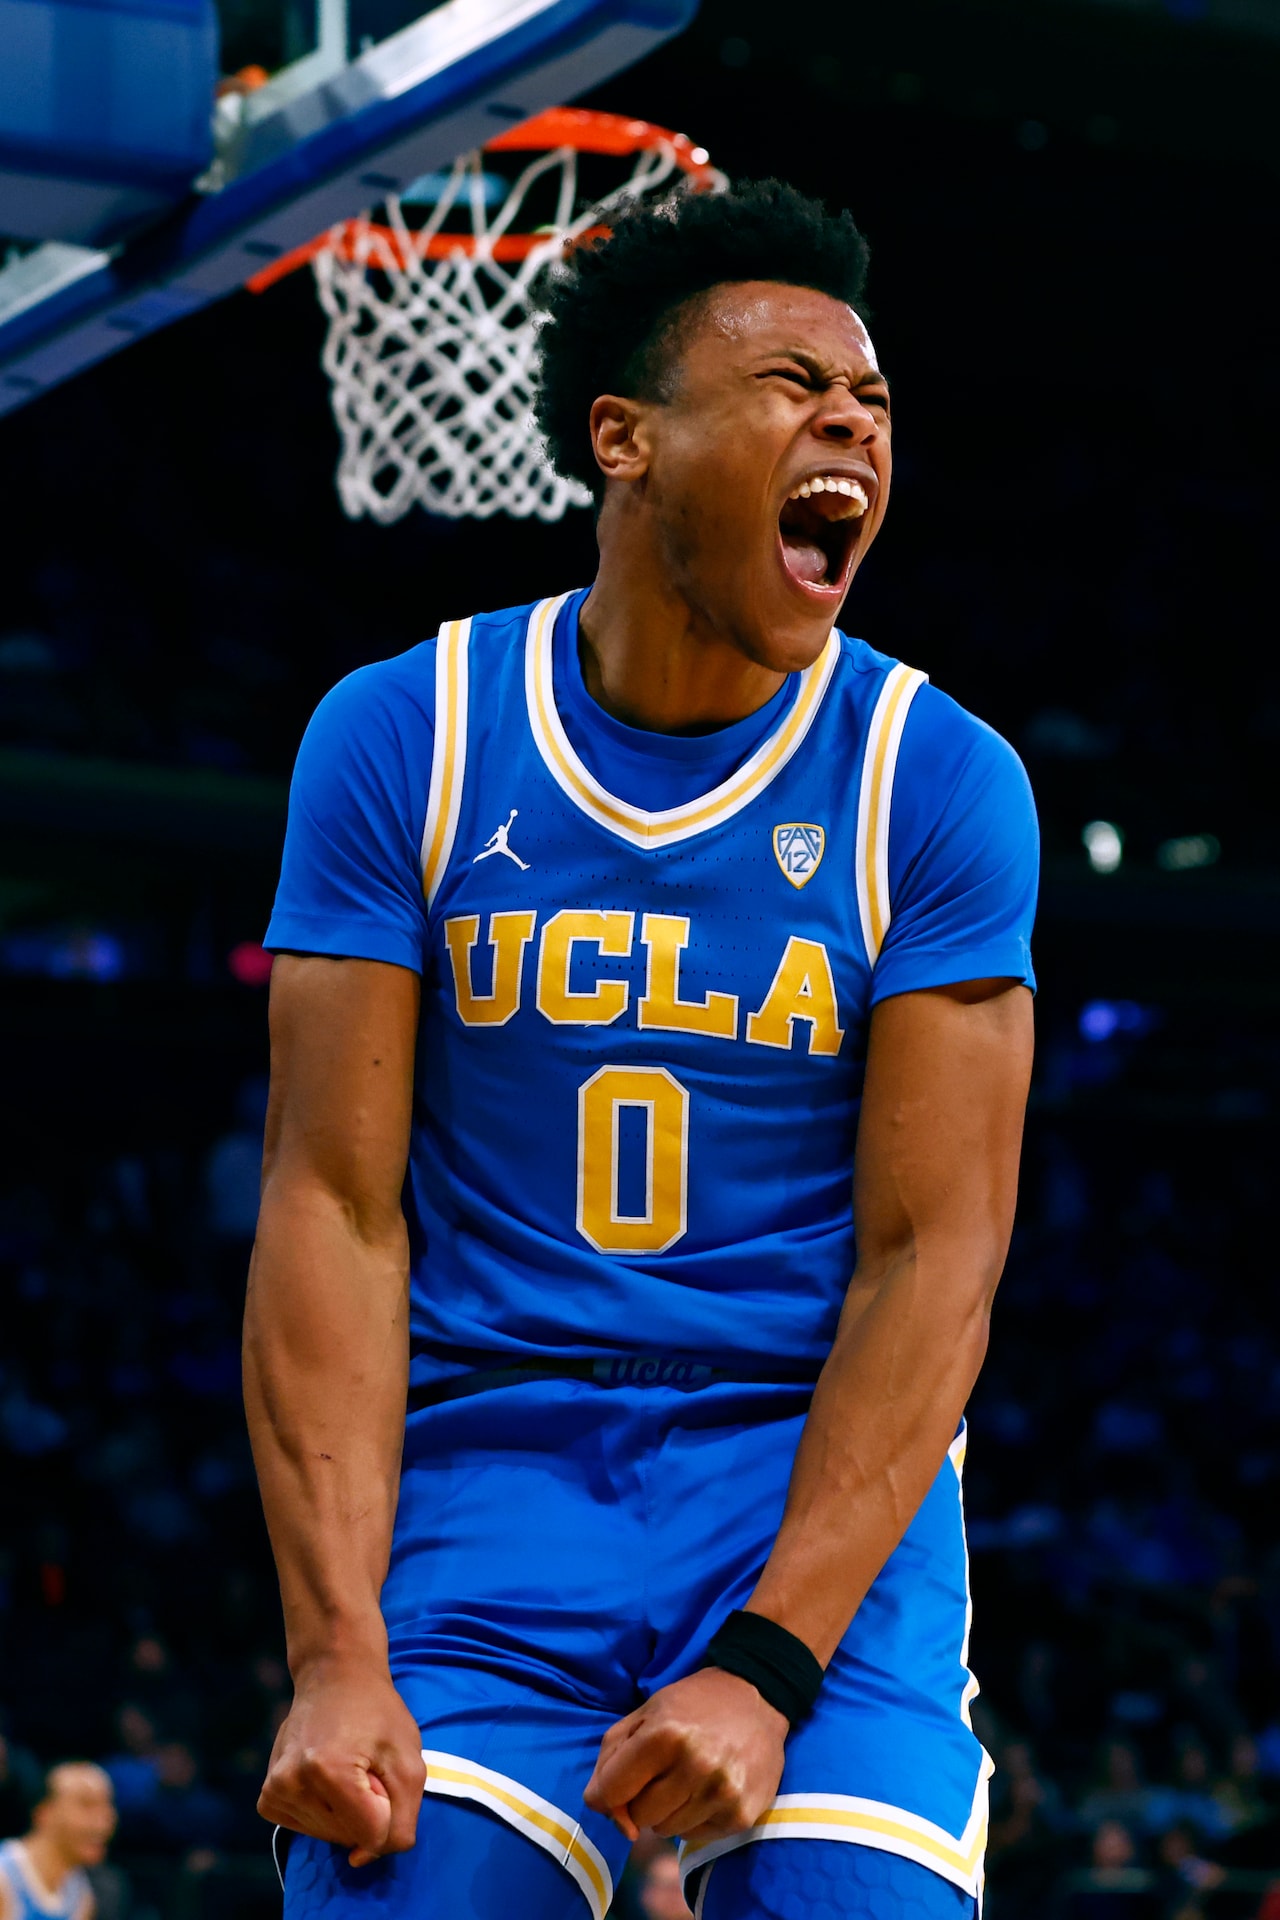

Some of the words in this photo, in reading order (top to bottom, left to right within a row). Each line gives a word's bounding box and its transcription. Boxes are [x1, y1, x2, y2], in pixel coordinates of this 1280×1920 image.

[777, 827, 821, 861] PAC
[787, 850, 811, 873] 12
[444, 909, 845, 1056] UCLA
[576, 1065, 690, 1255] 0
